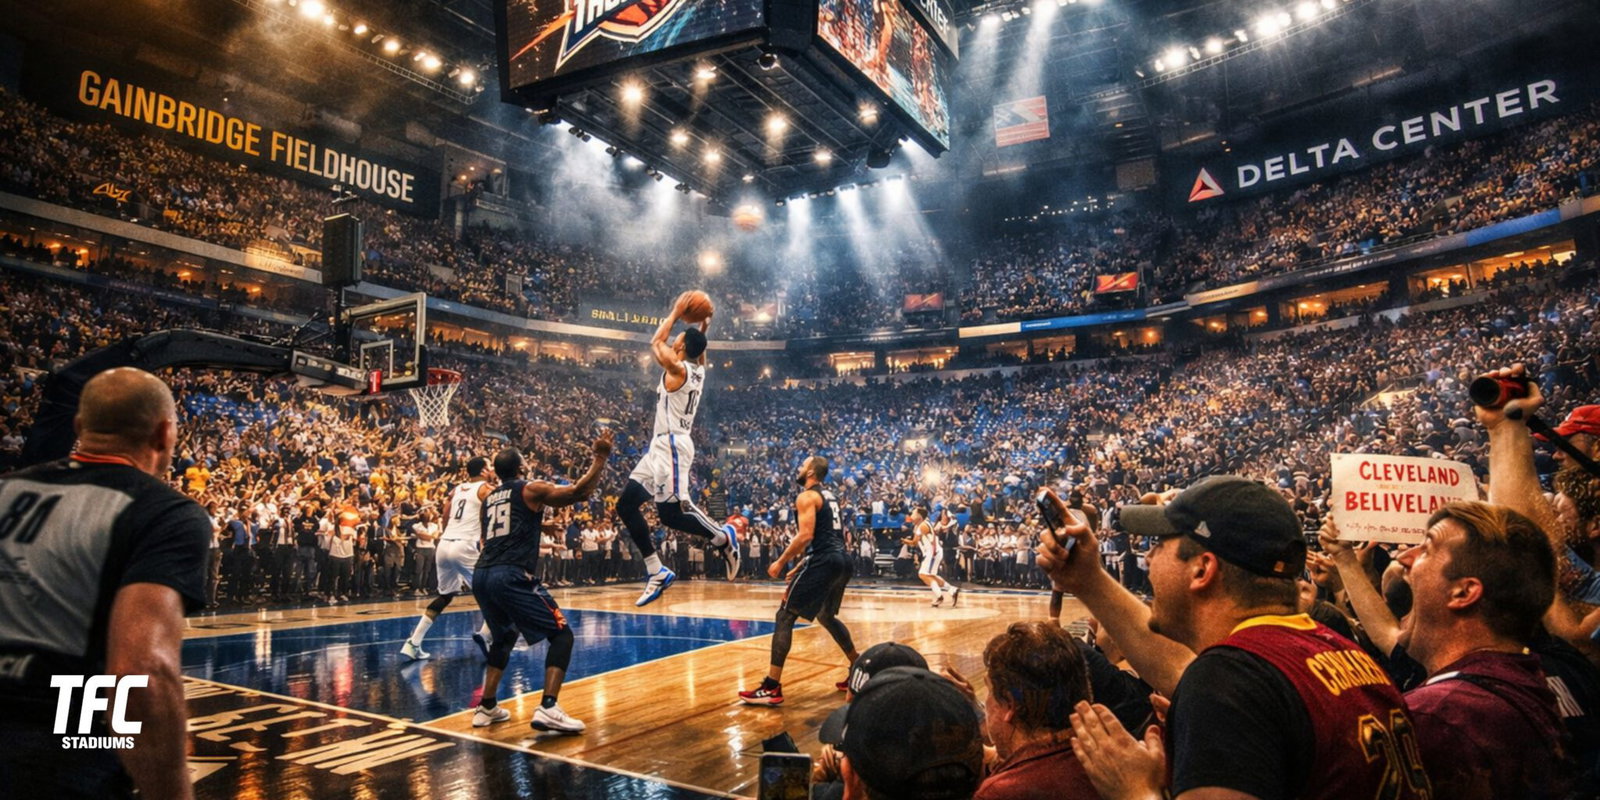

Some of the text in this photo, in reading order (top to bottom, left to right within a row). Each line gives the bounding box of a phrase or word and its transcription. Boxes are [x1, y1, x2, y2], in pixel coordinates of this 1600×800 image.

[79, 70, 415, 203] GAINBRIDGE FIELDHOUSE
[1237, 79, 1561, 189] DELTA CENTER
[1345, 491, 1462, 515] BELIVELA
[1359, 460, 1460, 487] CLEVELAND
